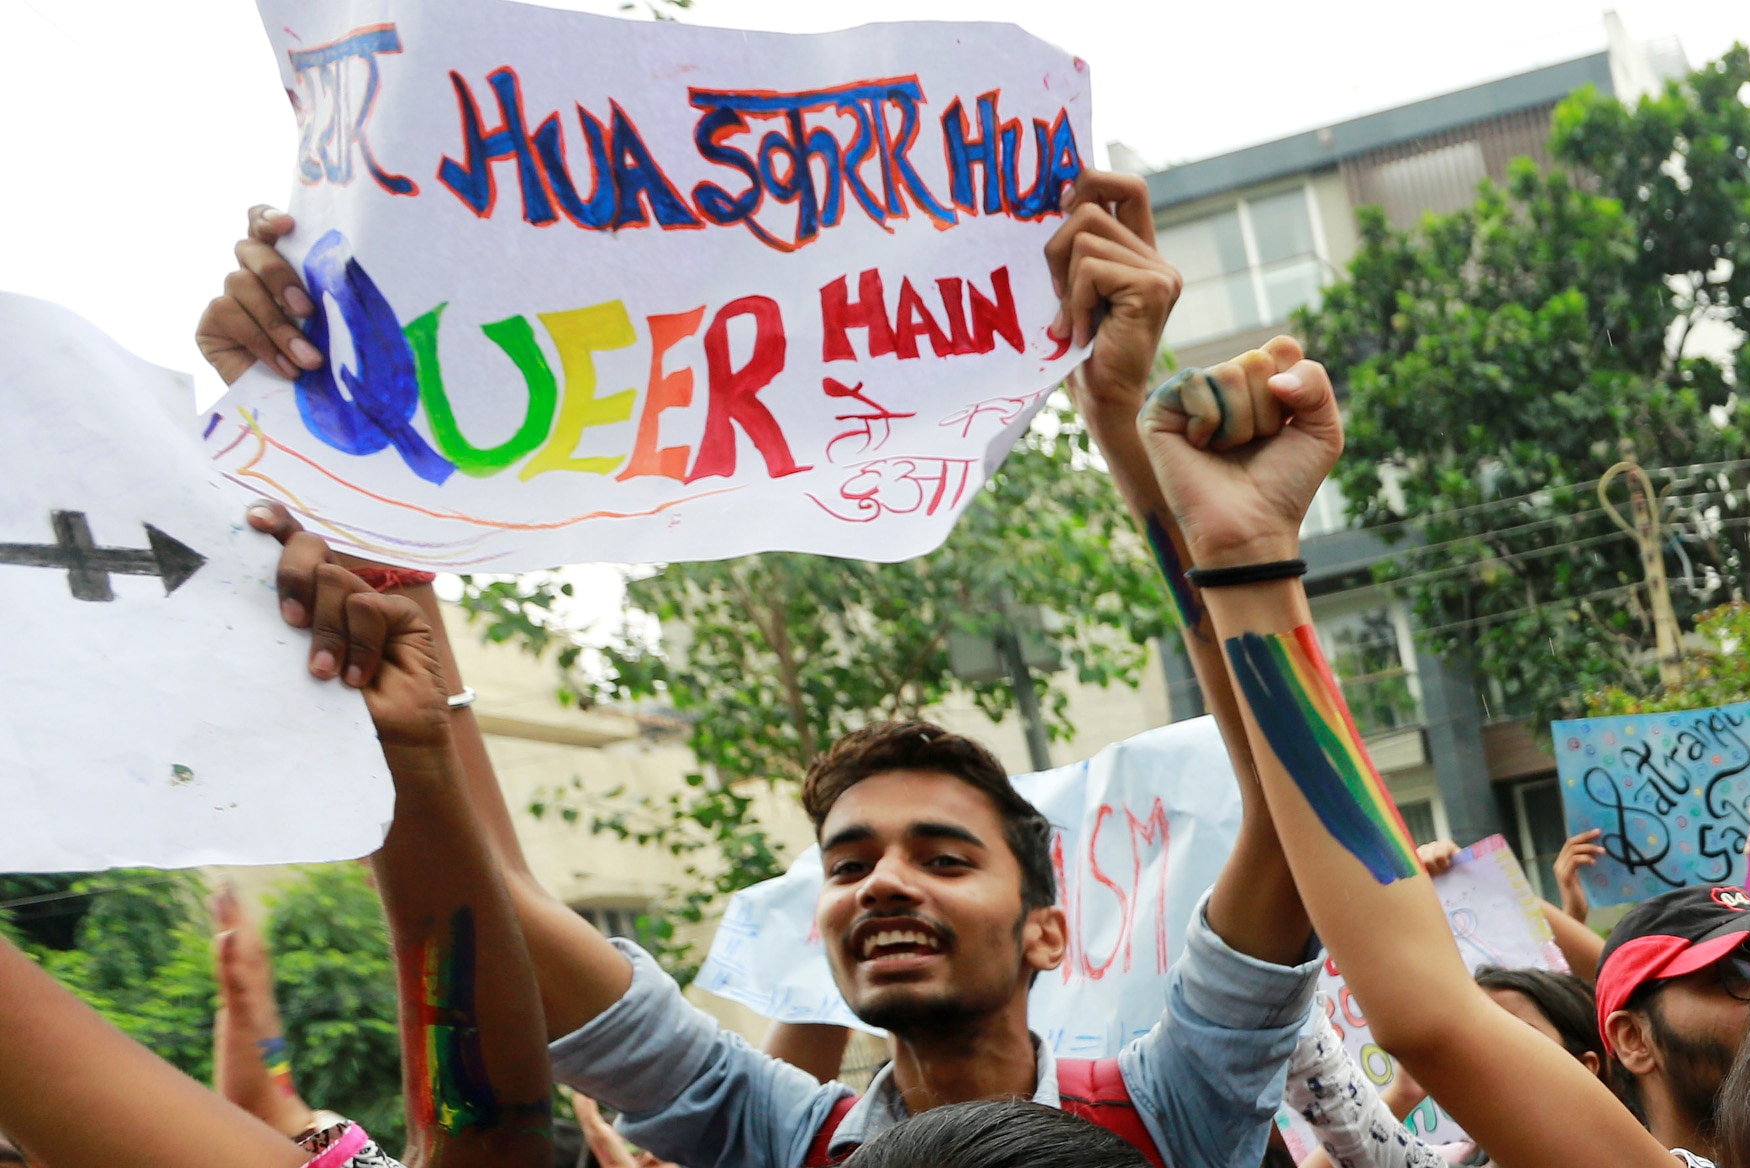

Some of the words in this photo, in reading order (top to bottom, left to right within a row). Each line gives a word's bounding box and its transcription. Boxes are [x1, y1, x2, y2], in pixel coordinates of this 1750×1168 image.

[436, 65, 703, 232] HUA
[941, 88, 1086, 223] HUA
[294, 230, 812, 486] QUEER
